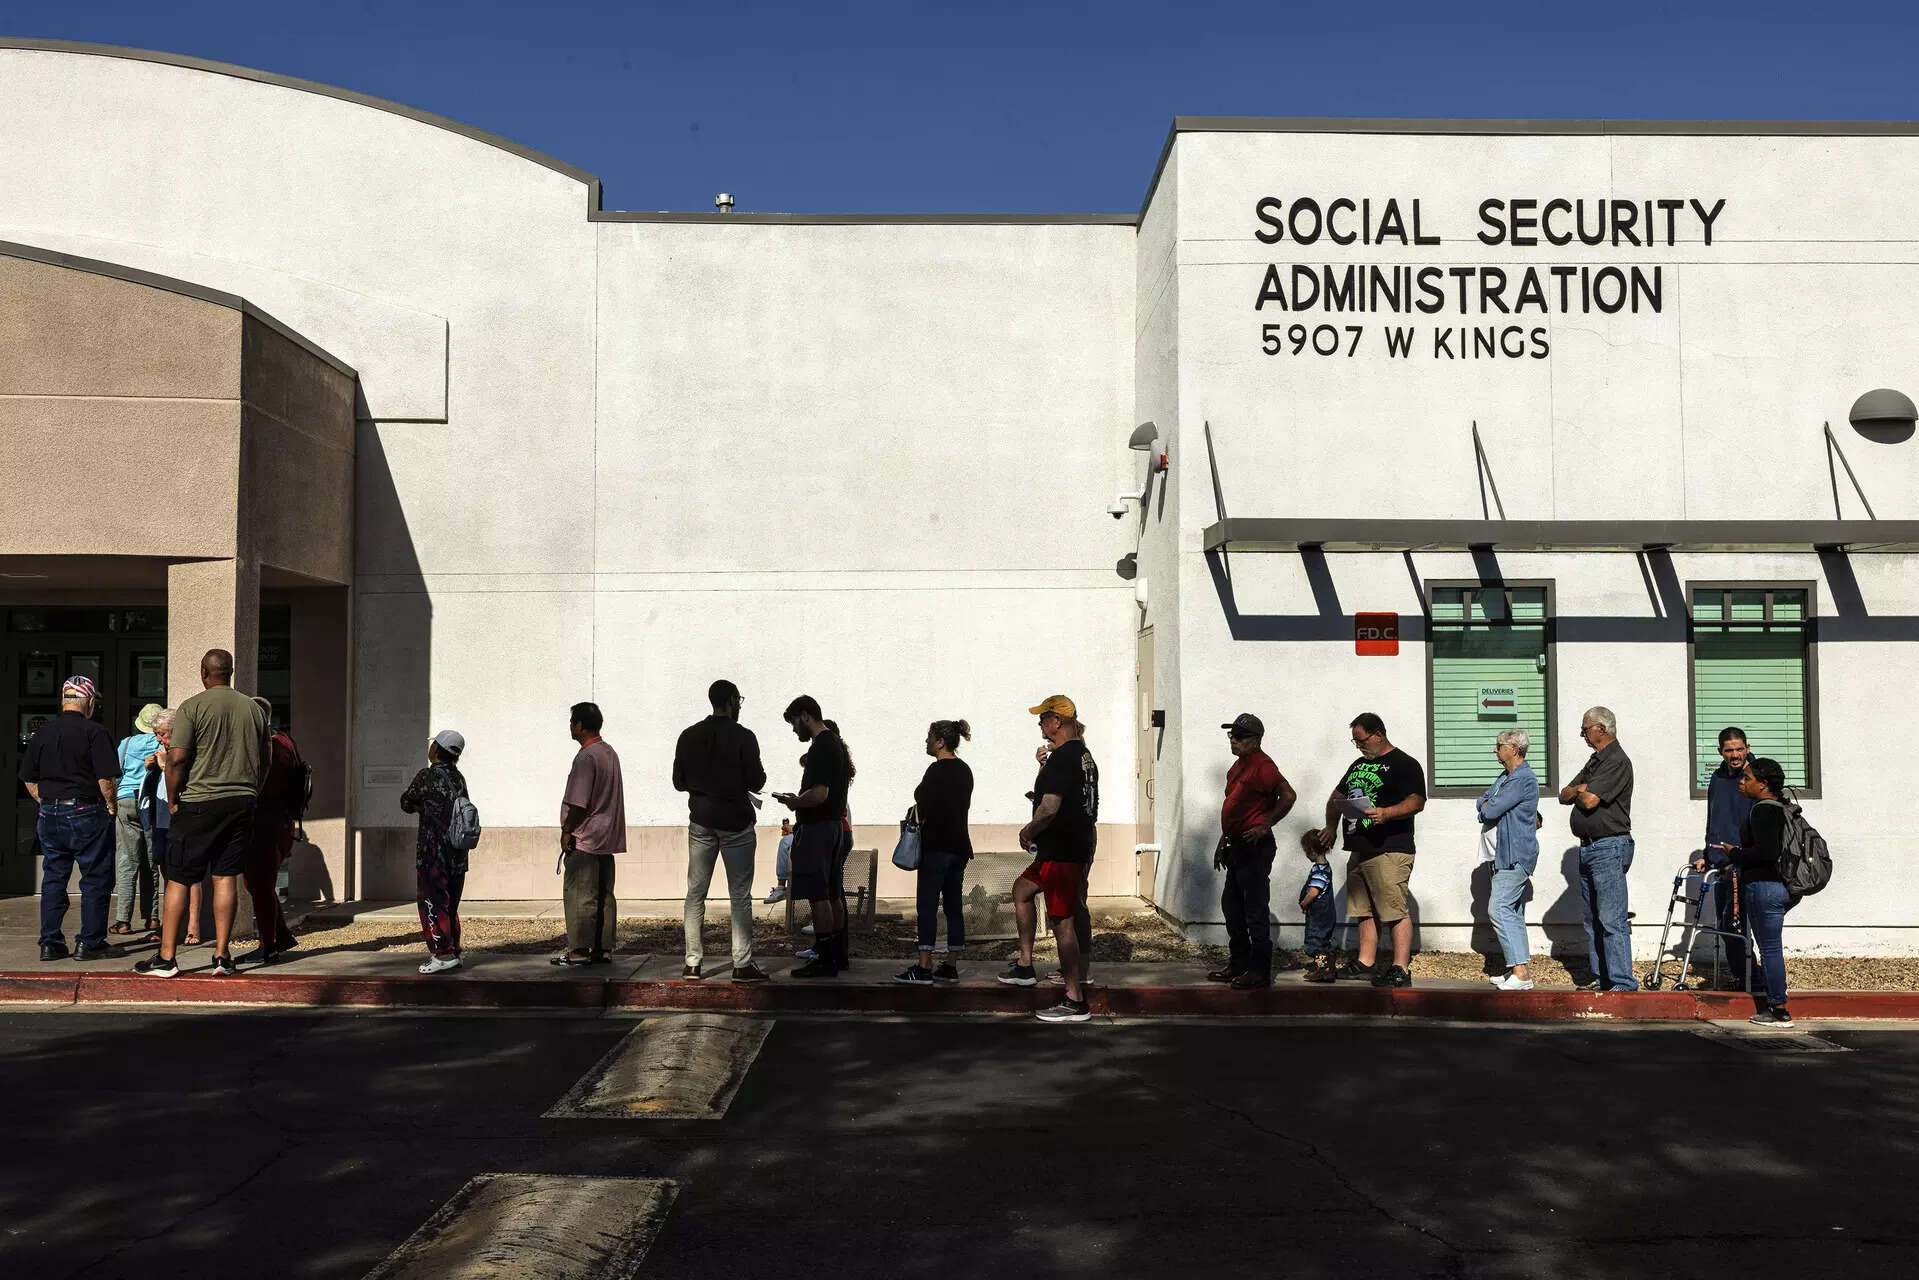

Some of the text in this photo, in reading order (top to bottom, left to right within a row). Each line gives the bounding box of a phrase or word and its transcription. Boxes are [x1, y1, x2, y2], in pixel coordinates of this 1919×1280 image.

[1254, 196, 1726, 248] SOCIAL SECURITY
[1254, 263, 1662, 315] ADMINISTRATION
[1262, 323, 1550, 360] 5907 W KINGS
